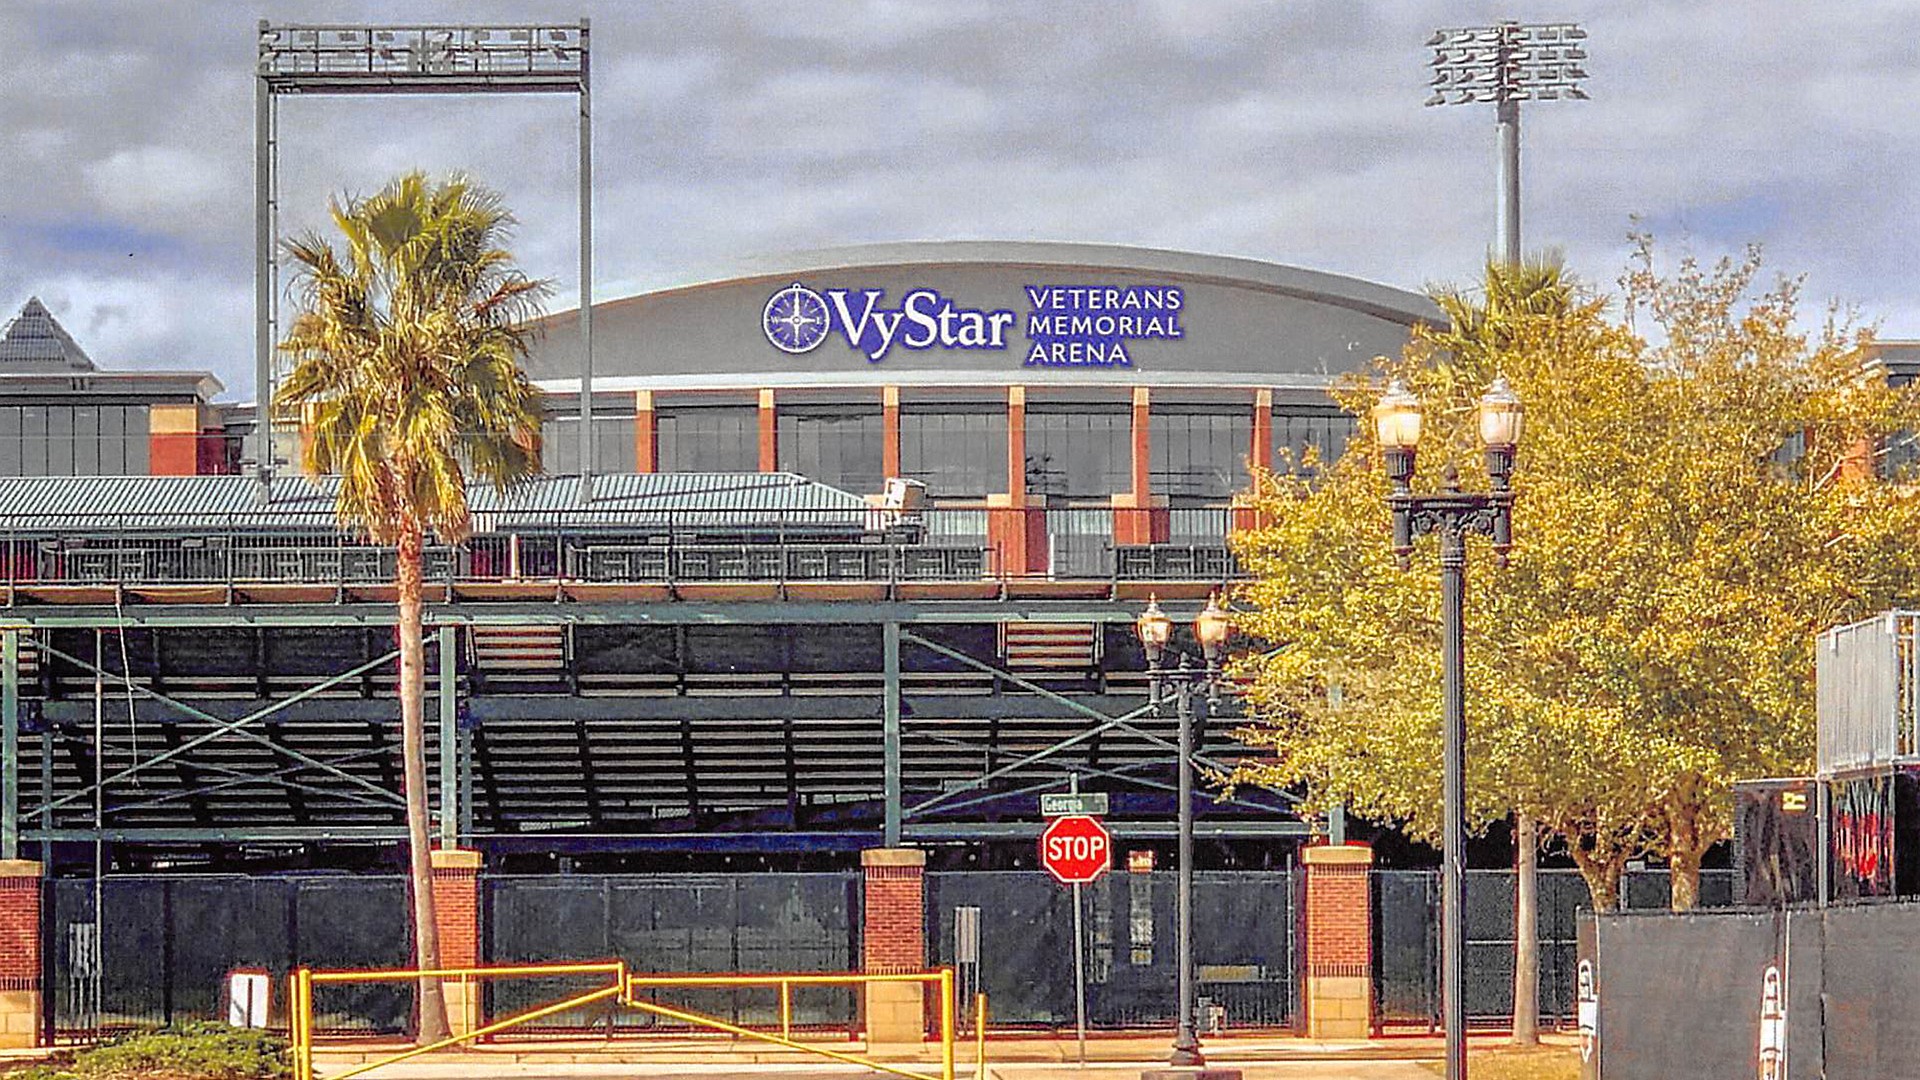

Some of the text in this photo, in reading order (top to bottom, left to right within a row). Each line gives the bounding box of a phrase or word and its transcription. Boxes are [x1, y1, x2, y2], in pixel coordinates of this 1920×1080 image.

[1029, 289, 1181, 310] VETERANS
[828, 291, 1013, 360] VyStar
[1030, 316, 1181, 335] MEMORIAL
[1029, 343, 1128, 363] ARENA
[1048, 836, 1104, 861] STOP
